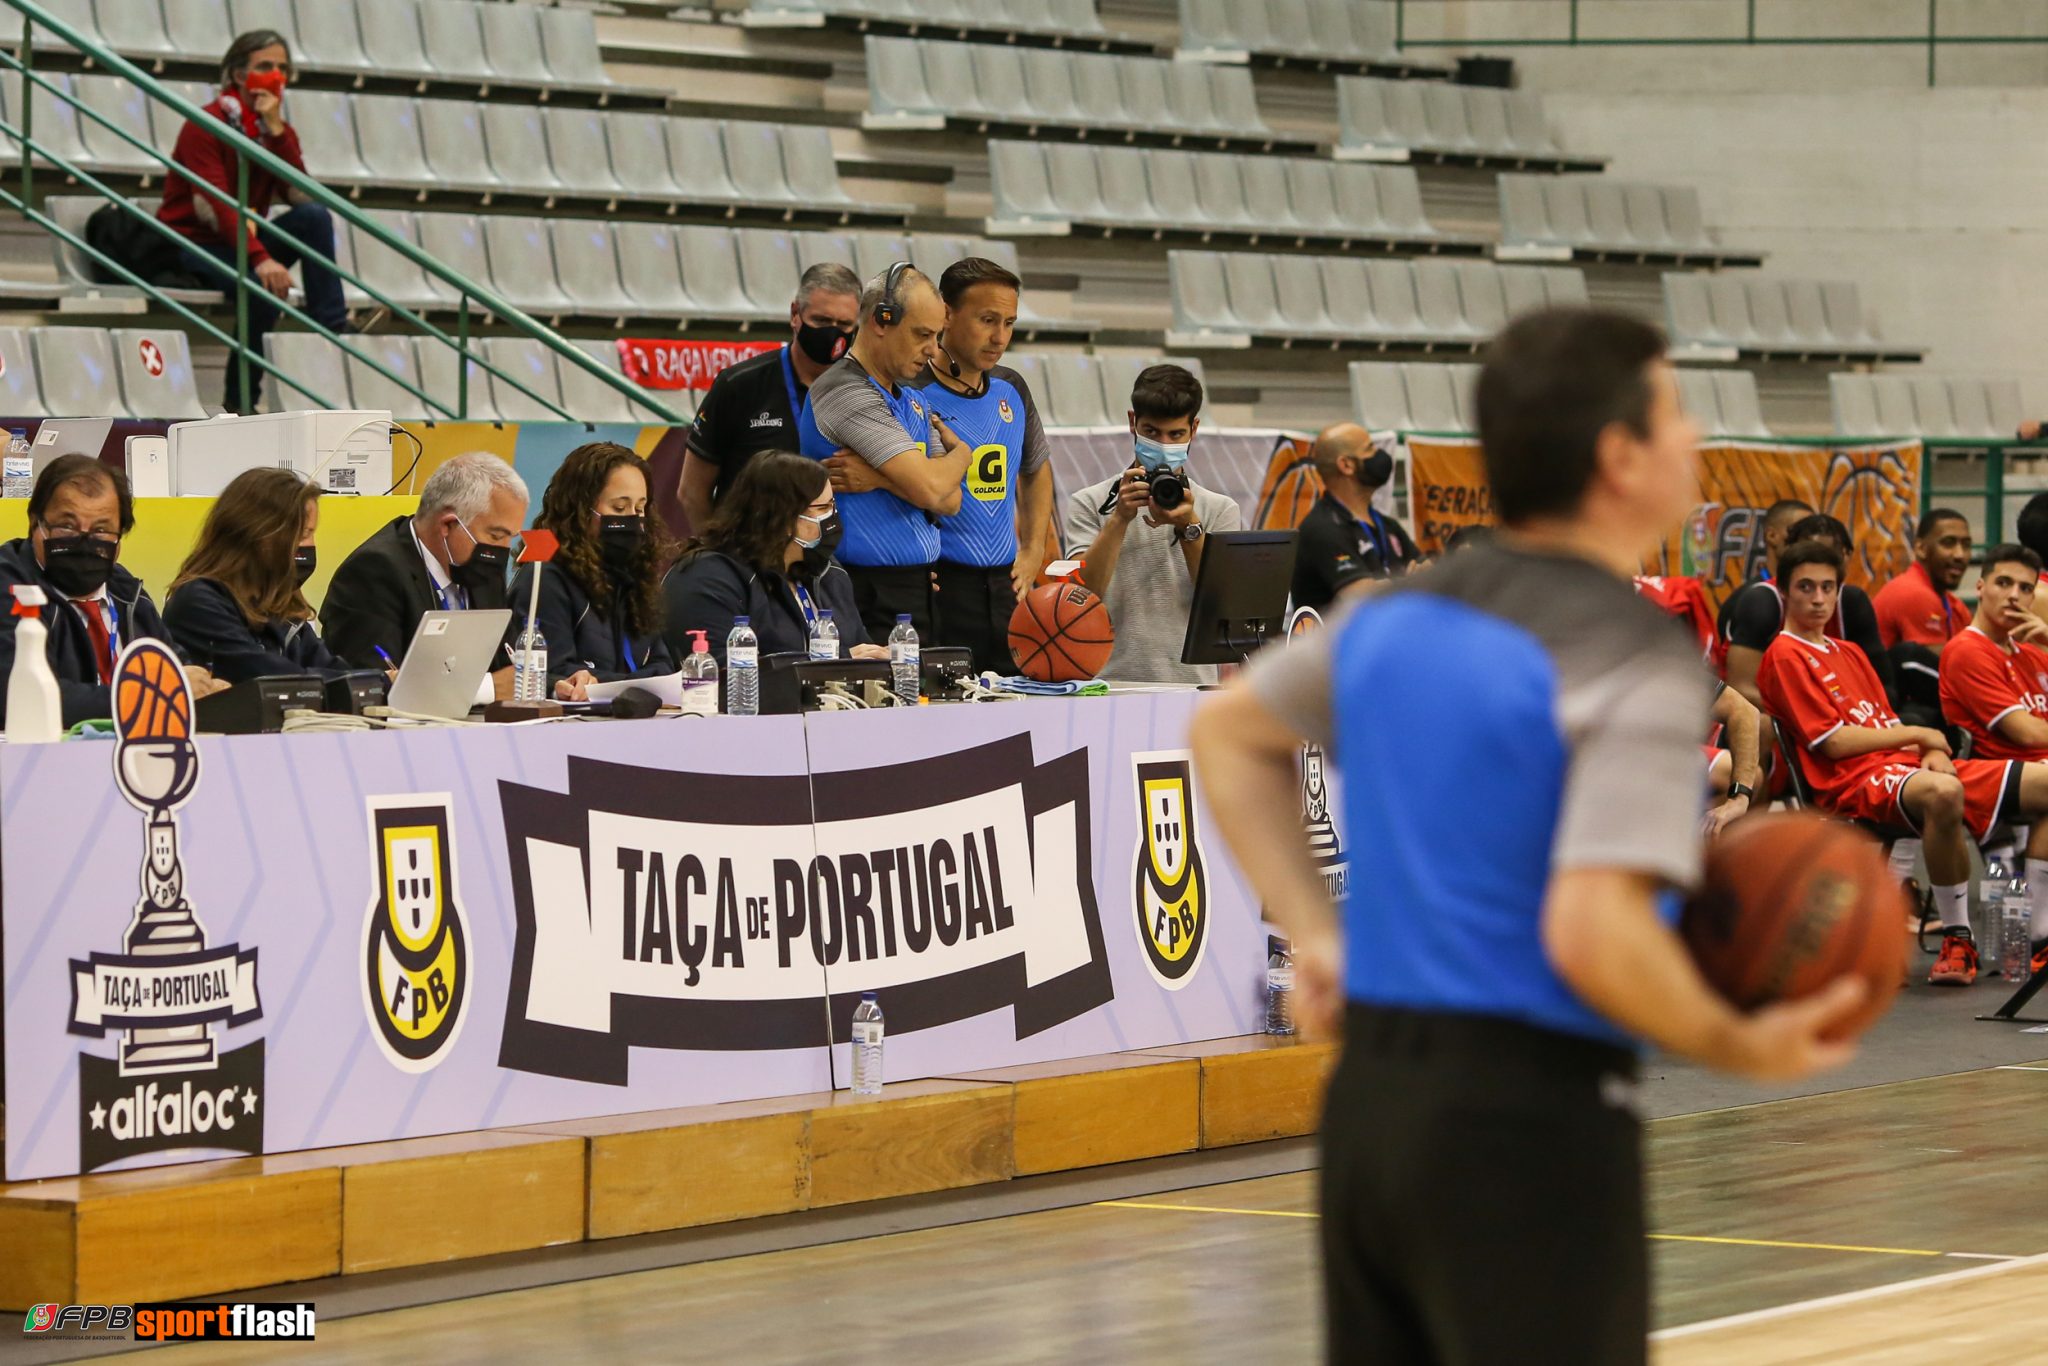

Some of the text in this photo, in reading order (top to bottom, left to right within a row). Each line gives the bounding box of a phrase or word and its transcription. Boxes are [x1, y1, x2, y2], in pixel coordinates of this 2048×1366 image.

[978, 451, 1003, 483] G
[973, 486, 1005, 494] GOLDCAR
[1308, 798, 1323, 818] FPB
[153, 881, 177, 904] FPB
[616, 825, 1015, 987] TAÇA DE PORTUGAL
[1154, 899, 1195, 954] FPB
[103, 975, 142, 1012] TAÇA
[152, 968, 230, 1007] PORTUGAL
[390, 967, 450, 1031] FPB
[109, 1080, 235, 1141] alfaloc
